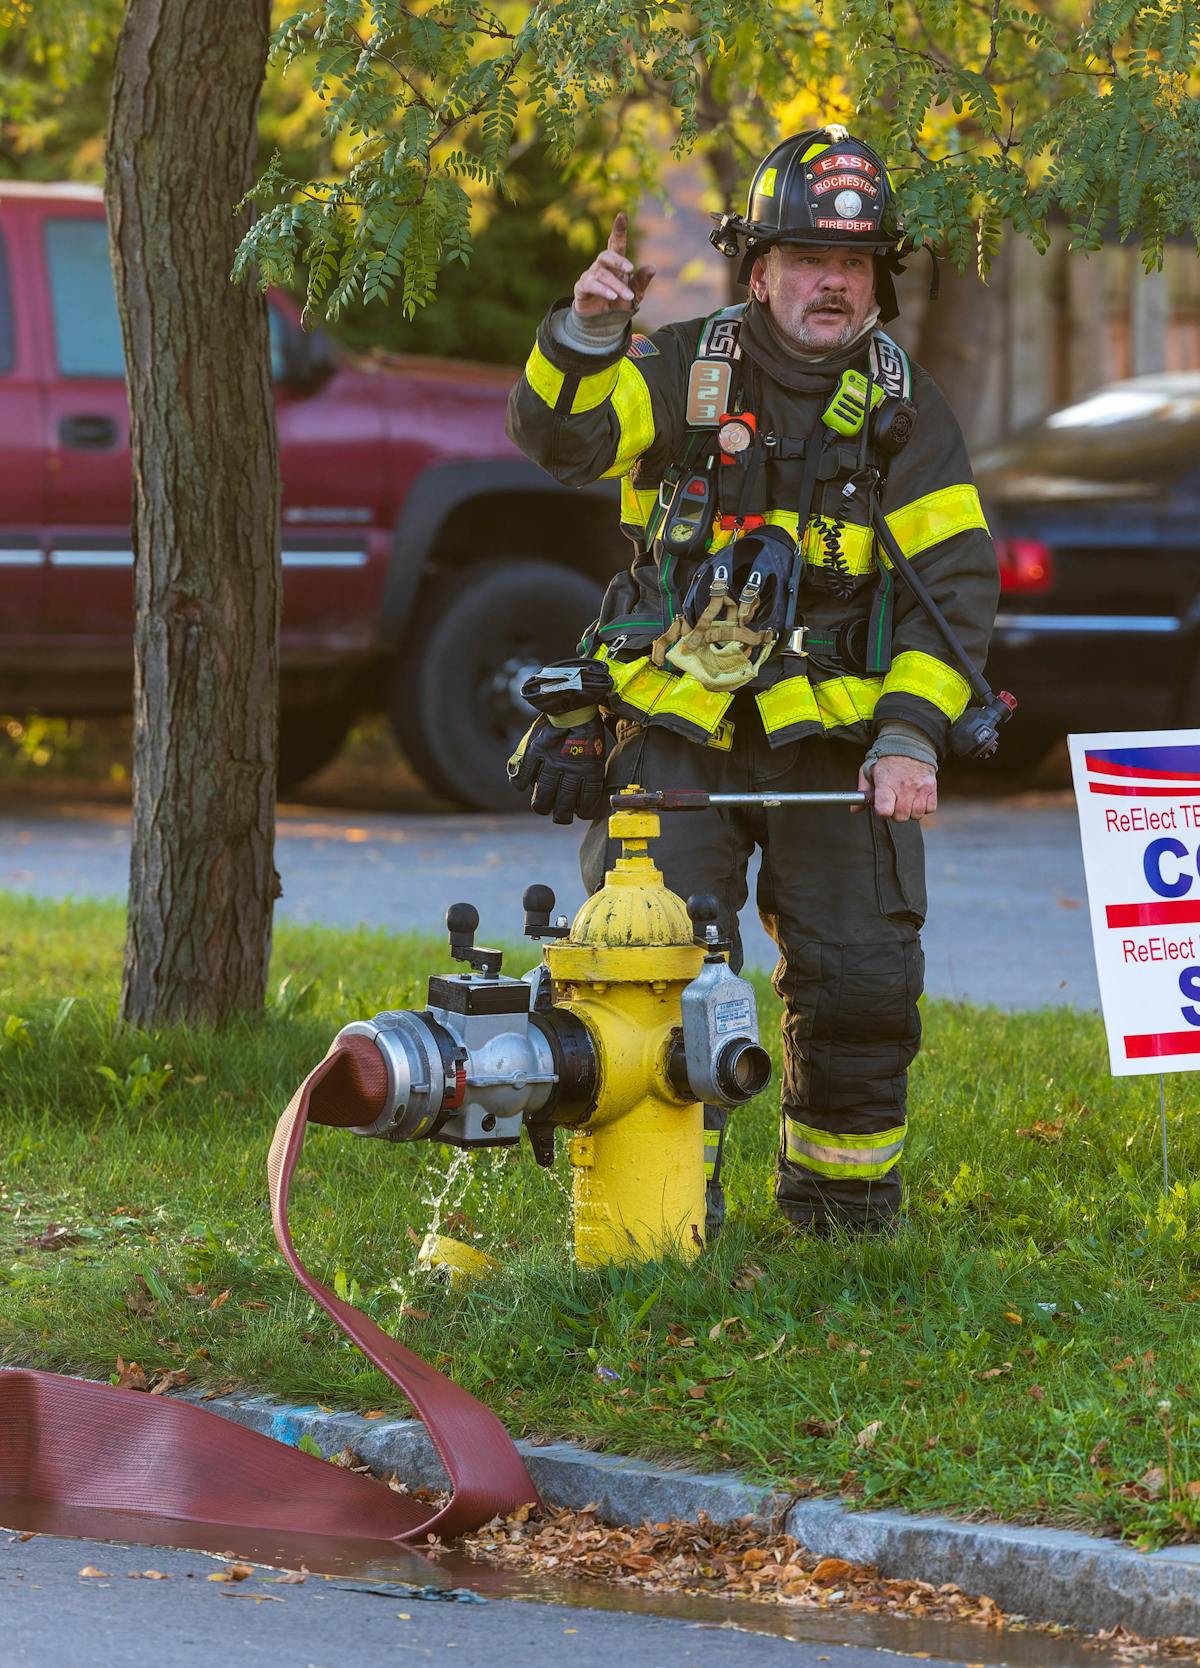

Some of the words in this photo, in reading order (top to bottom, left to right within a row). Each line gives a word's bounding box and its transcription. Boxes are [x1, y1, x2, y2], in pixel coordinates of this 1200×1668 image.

[820, 156, 873, 172] EAST
[815, 176, 878, 196] ROCHESTER
[819, 220, 844, 230] FIRE
[846, 221, 873, 231] DEPT
[695, 367, 721, 419] 323
[1105, 807, 1177, 833] ReElect
[1122, 936, 1196, 963] ReElect
